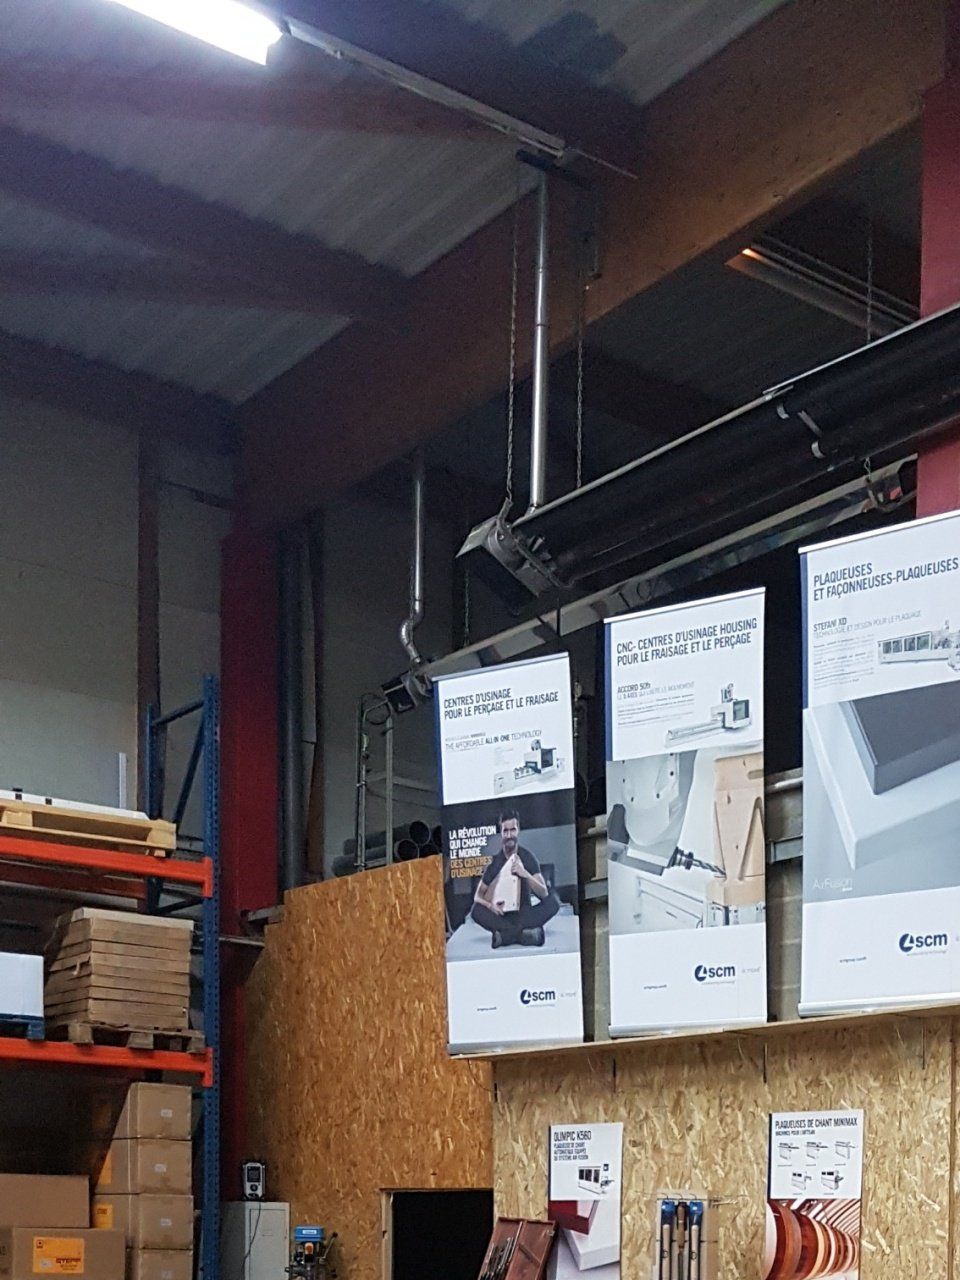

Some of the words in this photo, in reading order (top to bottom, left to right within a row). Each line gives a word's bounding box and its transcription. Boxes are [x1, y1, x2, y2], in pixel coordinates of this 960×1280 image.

[814, 563, 872, 586] PLAQUEUSES
[814, 588, 824, 601] ET
[827, 558, 958, 599] FAÇONNEUSES-PLAQUEUSES
[814, 619, 836, 632] STEFANI
[638, 634, 672, 650] CENTRES
[676, 626, 717, 643] D'USINAGE
[720, 618, 757, 634] HOUSING
[617, 655, 638, 666] POUR
[641, 652, 648, 662] LE
[651, 644, 688, 660] FRAISAGE
[691, 642, 700, 652] ET
[702, 640, 711, 650] LE
[715, 632, 751, 649] PERÇAGE
[618, 684, 638, 693] ACCORD
[444, 694, 473, 708] CENTRES
[476, 688, 511, 704] D'USINAGE
[445, 708, 462, 720] POUR
[465, 708, 471, 716] LE
[474, 701, 503, 715] PERÇAGE
[506, 699, 514, 709] ET
[516, 698, 523, 708] LE
[526, 692, 558, 706] FRAISAGE
[449, 830, 457, 839] LA
[458, 825, 496, 838] RÉVOLUTION
[450, 840, 460, 849] QUI
[462, 837, 487, 848] CHANGE
[450, 849, 457, 859] LE
[459, 847, 481, 858] MONDE
[451, 859, 463, 868] DES
[465, 856, 492, 868] CENTRES
[916, 934, 947, 948] scm
[708, 966, 735, 978] scm
[532, 990, 555, 1001] scm
[776, 1120, 806, 1128] PLAQUEUSES
[807, 1119, 813, 1128] DE
[815, 1119, 832, 1127] CHANT
[834, 1118, 857, 1126] MINIMAX
